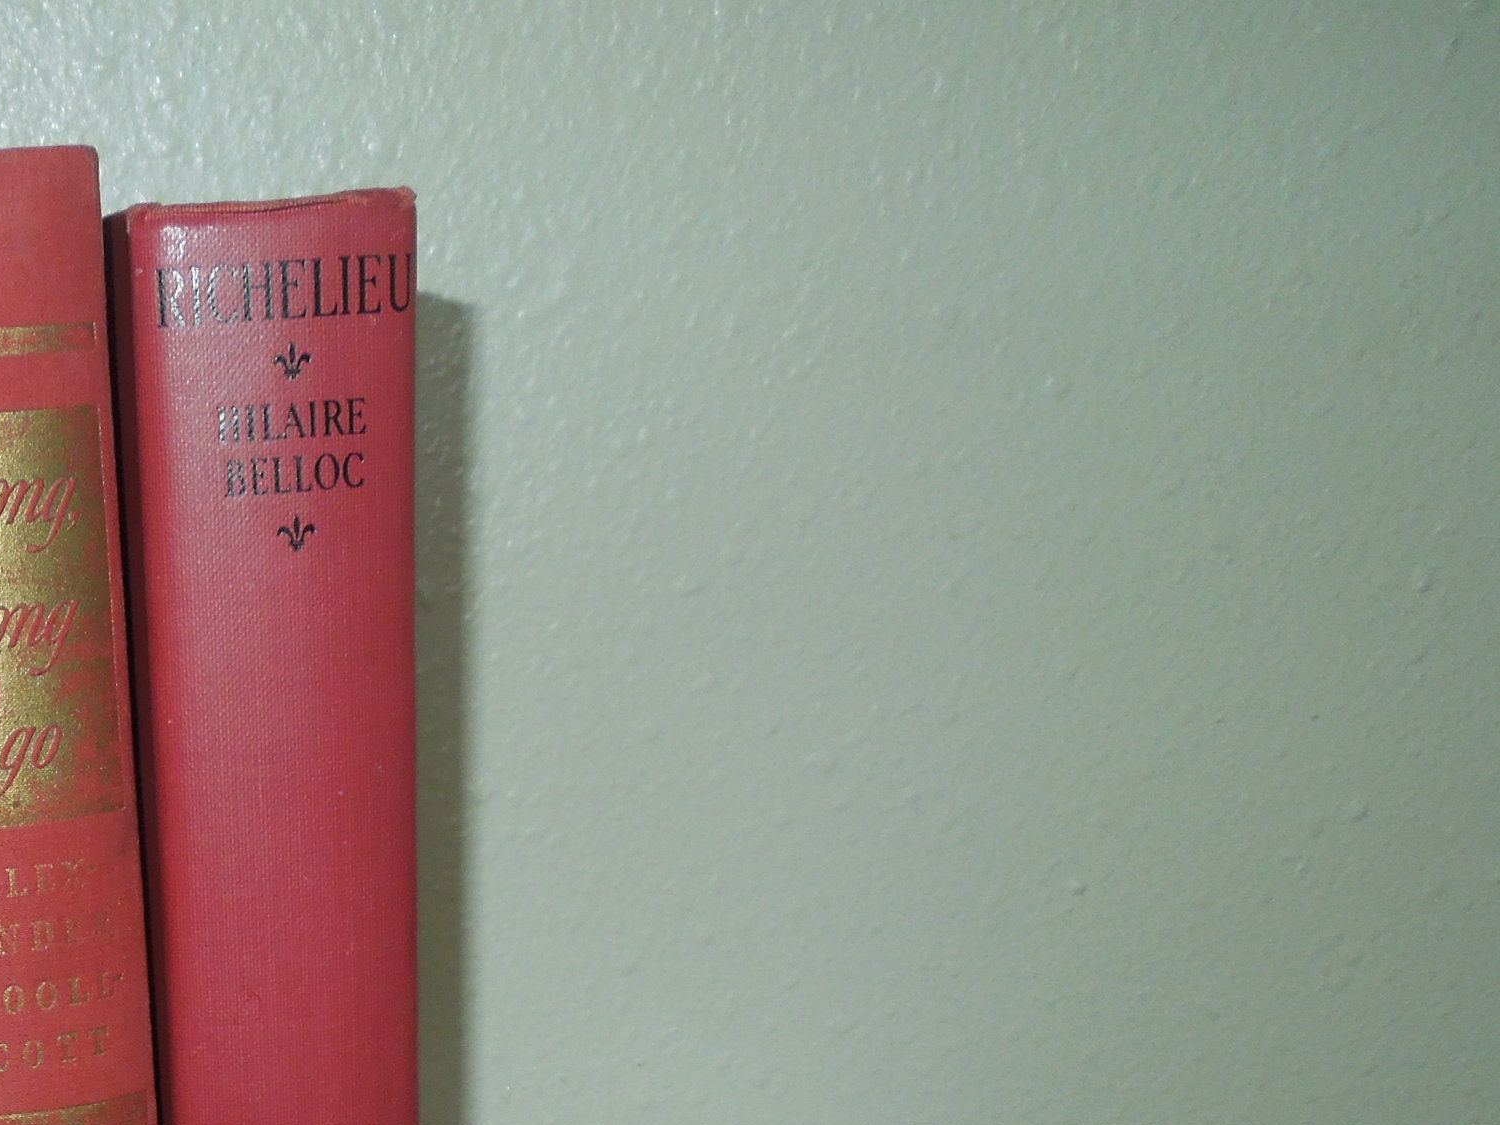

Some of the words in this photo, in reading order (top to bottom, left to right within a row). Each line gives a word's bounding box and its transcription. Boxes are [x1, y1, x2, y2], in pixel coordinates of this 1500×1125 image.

[157, 253, 413, 328] RICHELIEU
[217, 398, 368, 443] HILAIRE
[225, 452, 365, 498] BELLOC
